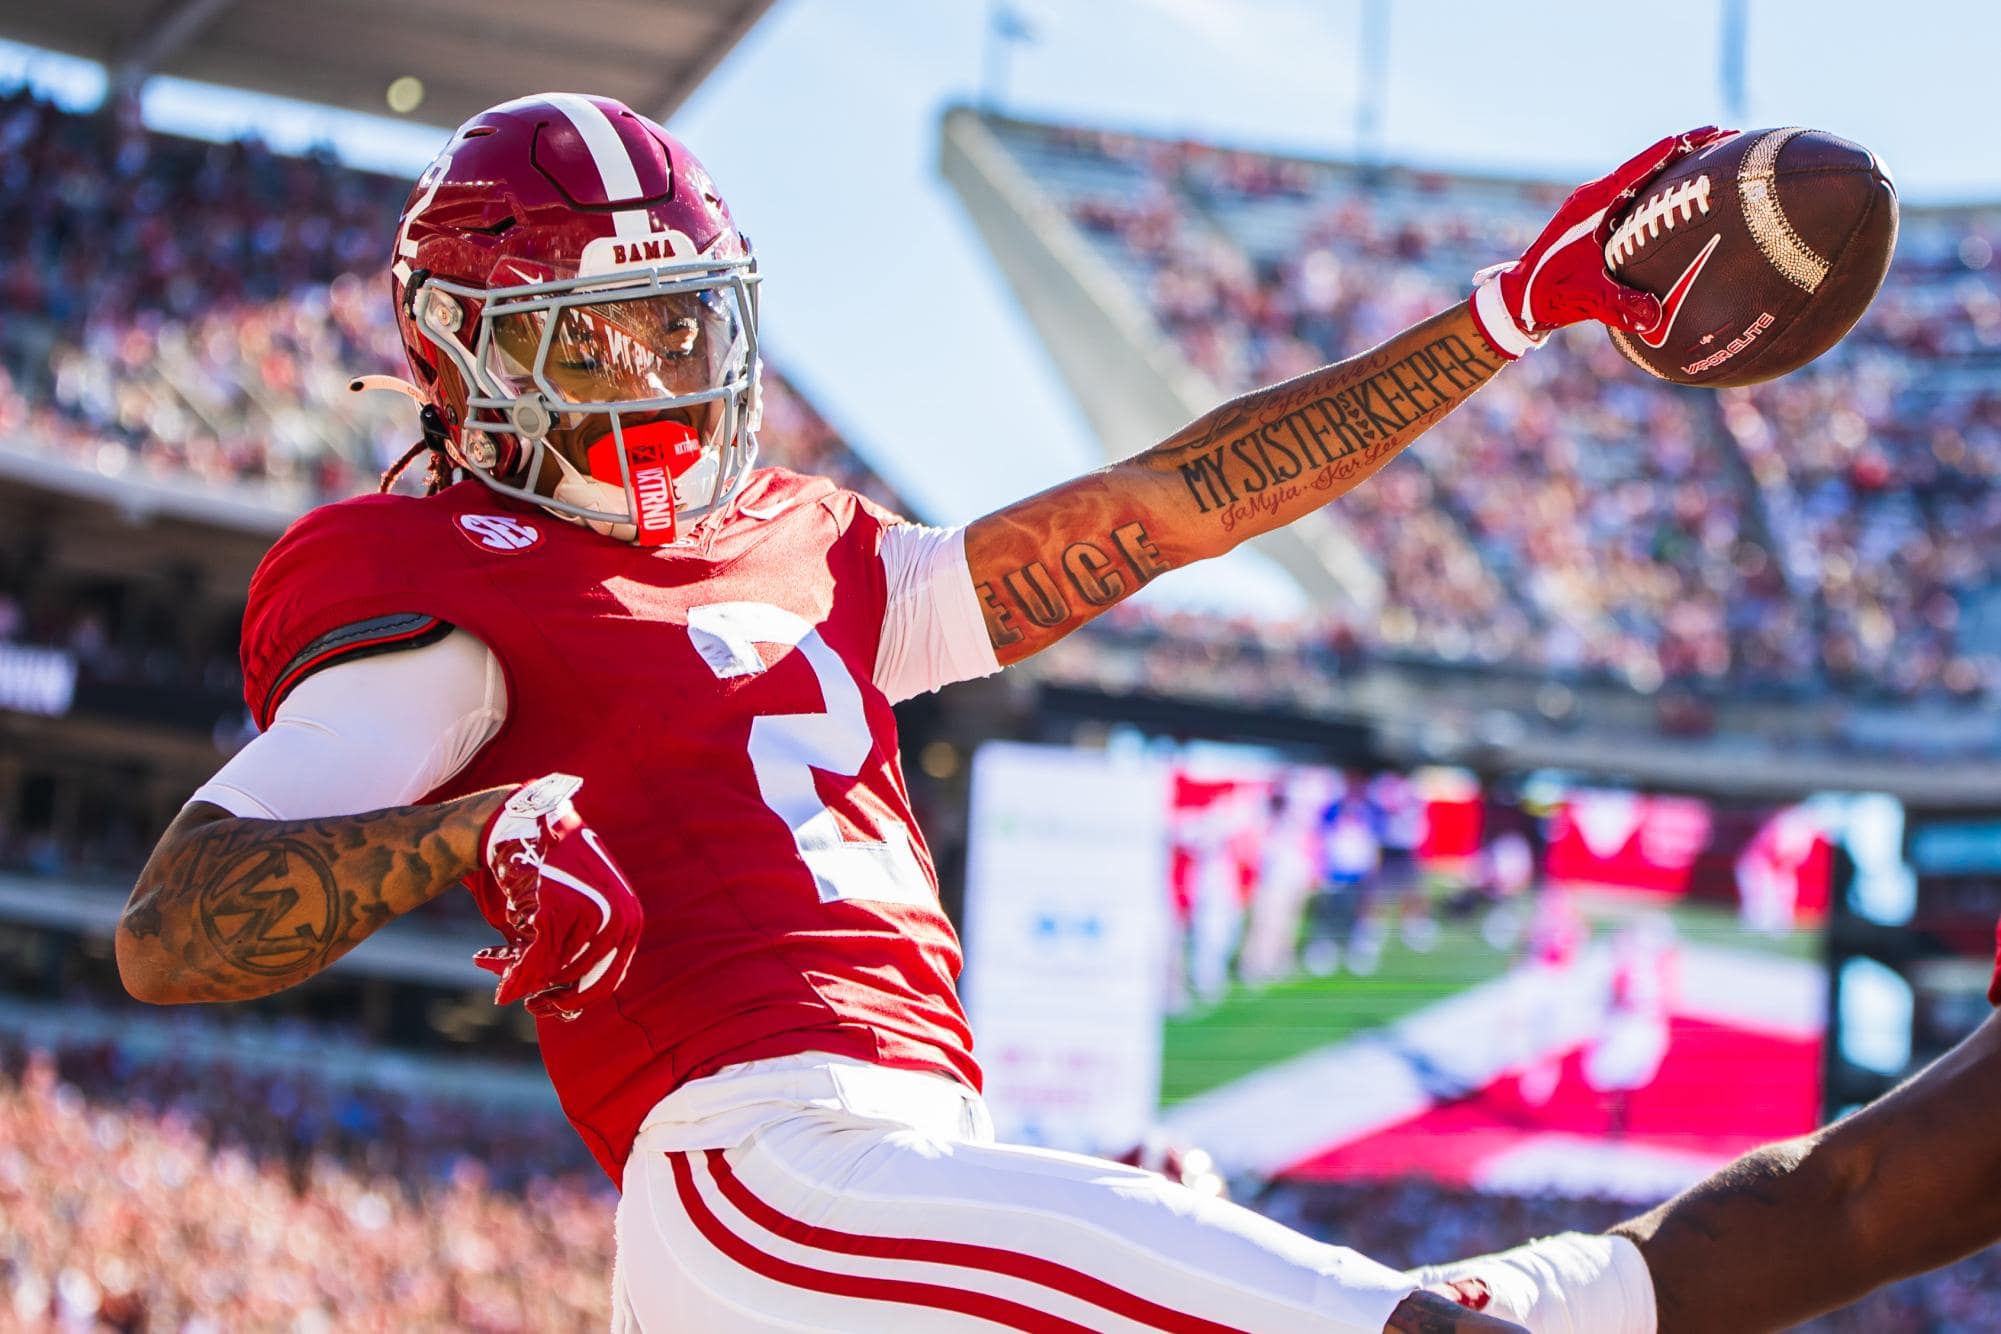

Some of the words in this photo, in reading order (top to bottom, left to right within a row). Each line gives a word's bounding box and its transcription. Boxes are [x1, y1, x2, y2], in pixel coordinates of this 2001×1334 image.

[613, 239, 676, 264] BAMA
[1180, 445, 1240, 513] MY
[1348, 333, 1498, 440] KEEPER
[460, 514, 538, 550] SEC
[687, 602, 942, 904] 2
